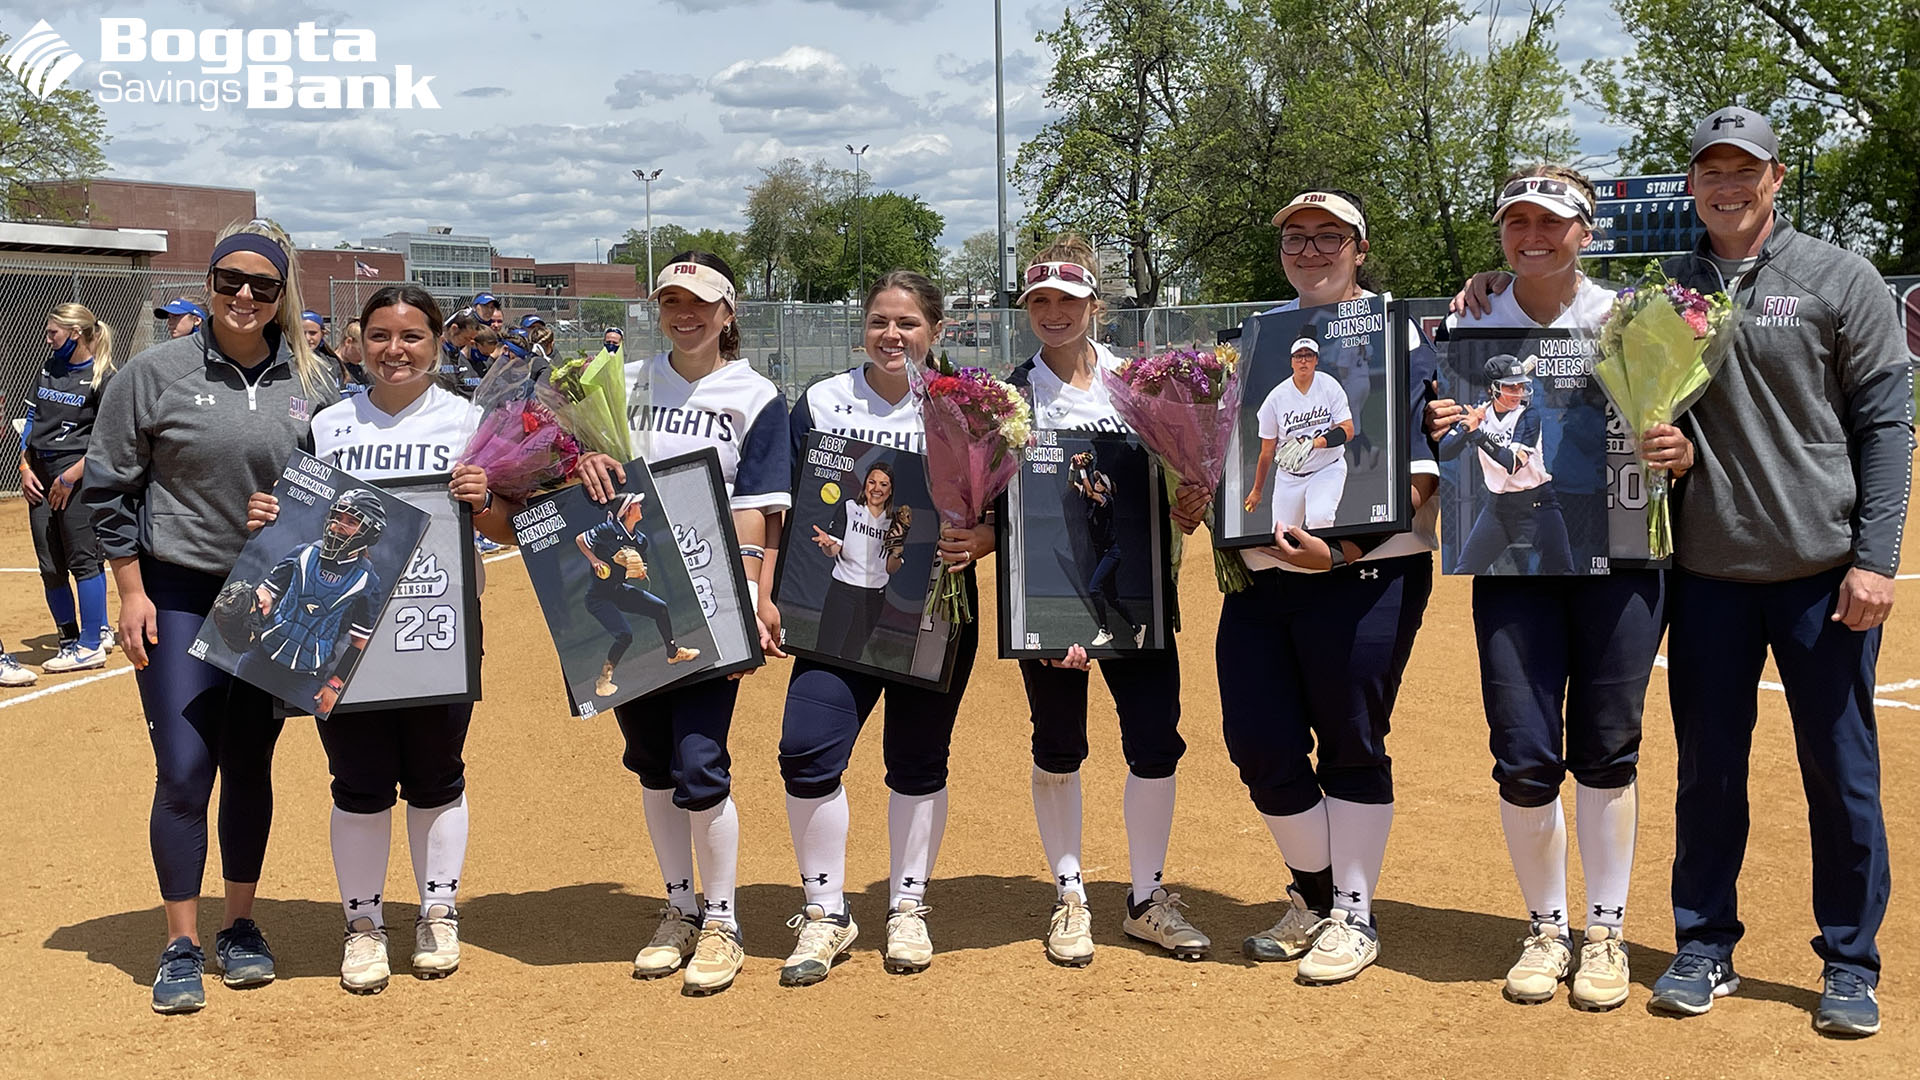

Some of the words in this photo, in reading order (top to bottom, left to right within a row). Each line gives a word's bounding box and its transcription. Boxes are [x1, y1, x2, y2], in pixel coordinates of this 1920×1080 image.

[1646, 181, 1686, 194] STRIKE
[1303, 195, 1327, 203] FDU
[1620, 204, 1626, 213] 1
[1635, 203, 1642, 212] 2
[1650, 202, 1658, 212] 3
[1667, 201, 1674, 211] 4
[1682, 201, 1690, 210] 5
[673, 264, 697, 275] FDU
[1338, 299, 1371, 318] ERICA
[1763, 295, 1800, 317] FDU
[1324, 313, 1382, 339] JOHNSON
[1755, 316, 1800, 328] SOFTBALL
[1540, 339, 1600, 357] MADISON
[55, 420, 78, 441] 7
[625, 404, 733, 442] KNIGHTS
[819, 434, 848, 454] ABBY
[332, 443, 450, 471] KNIGHTS
[807, 448, 854, 472] ENGLAND
[1025, 446, 1064, 462] SCHMEH
[299, 456, 332, 482] LOGAN
[282, 466, 336, 501] KOLEHMAINEN
[512, 500, 558, 530] SUMMER
[1371, 504, 1387, 516] FDU
[516, 514, 567, 546] MENDOZA
[852, 520, 889, 541] KNIGHT
[1592, 556, 1608, 568] FDU
[394, 604, 457, 653] 23
[1026, 632, 1040, 644] FDU
[192, 638, 210, 654] FDU
[579, 700, 594, 715] FDU
